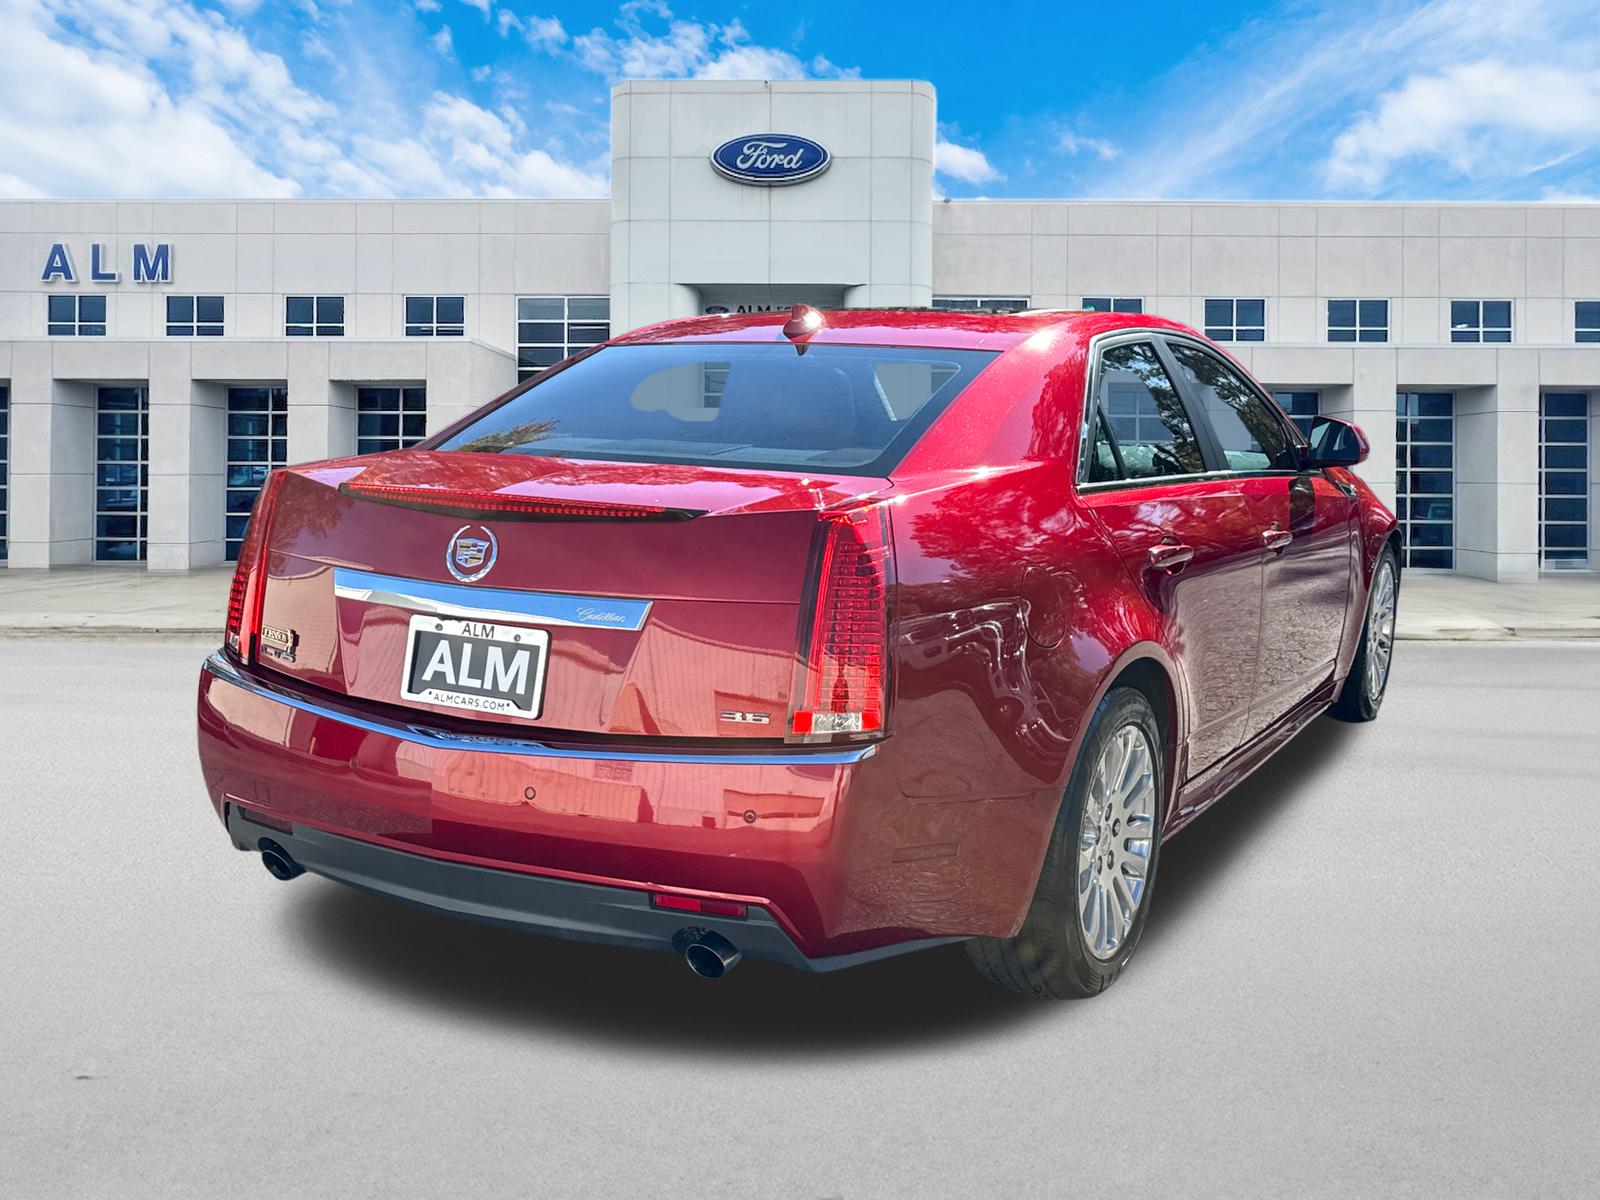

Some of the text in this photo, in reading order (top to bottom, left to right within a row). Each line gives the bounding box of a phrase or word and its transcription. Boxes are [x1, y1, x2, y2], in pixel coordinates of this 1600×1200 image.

[736, 141, 805, 169] Ford
[41, 243, 172, 282] ALM
[576, 607, 626, 622] Cadillac
[462, 623, 495, 639] ALM
[421, 639, 531, 696] ALM
[433, 693, 506, 711] ALMCARS.COM
